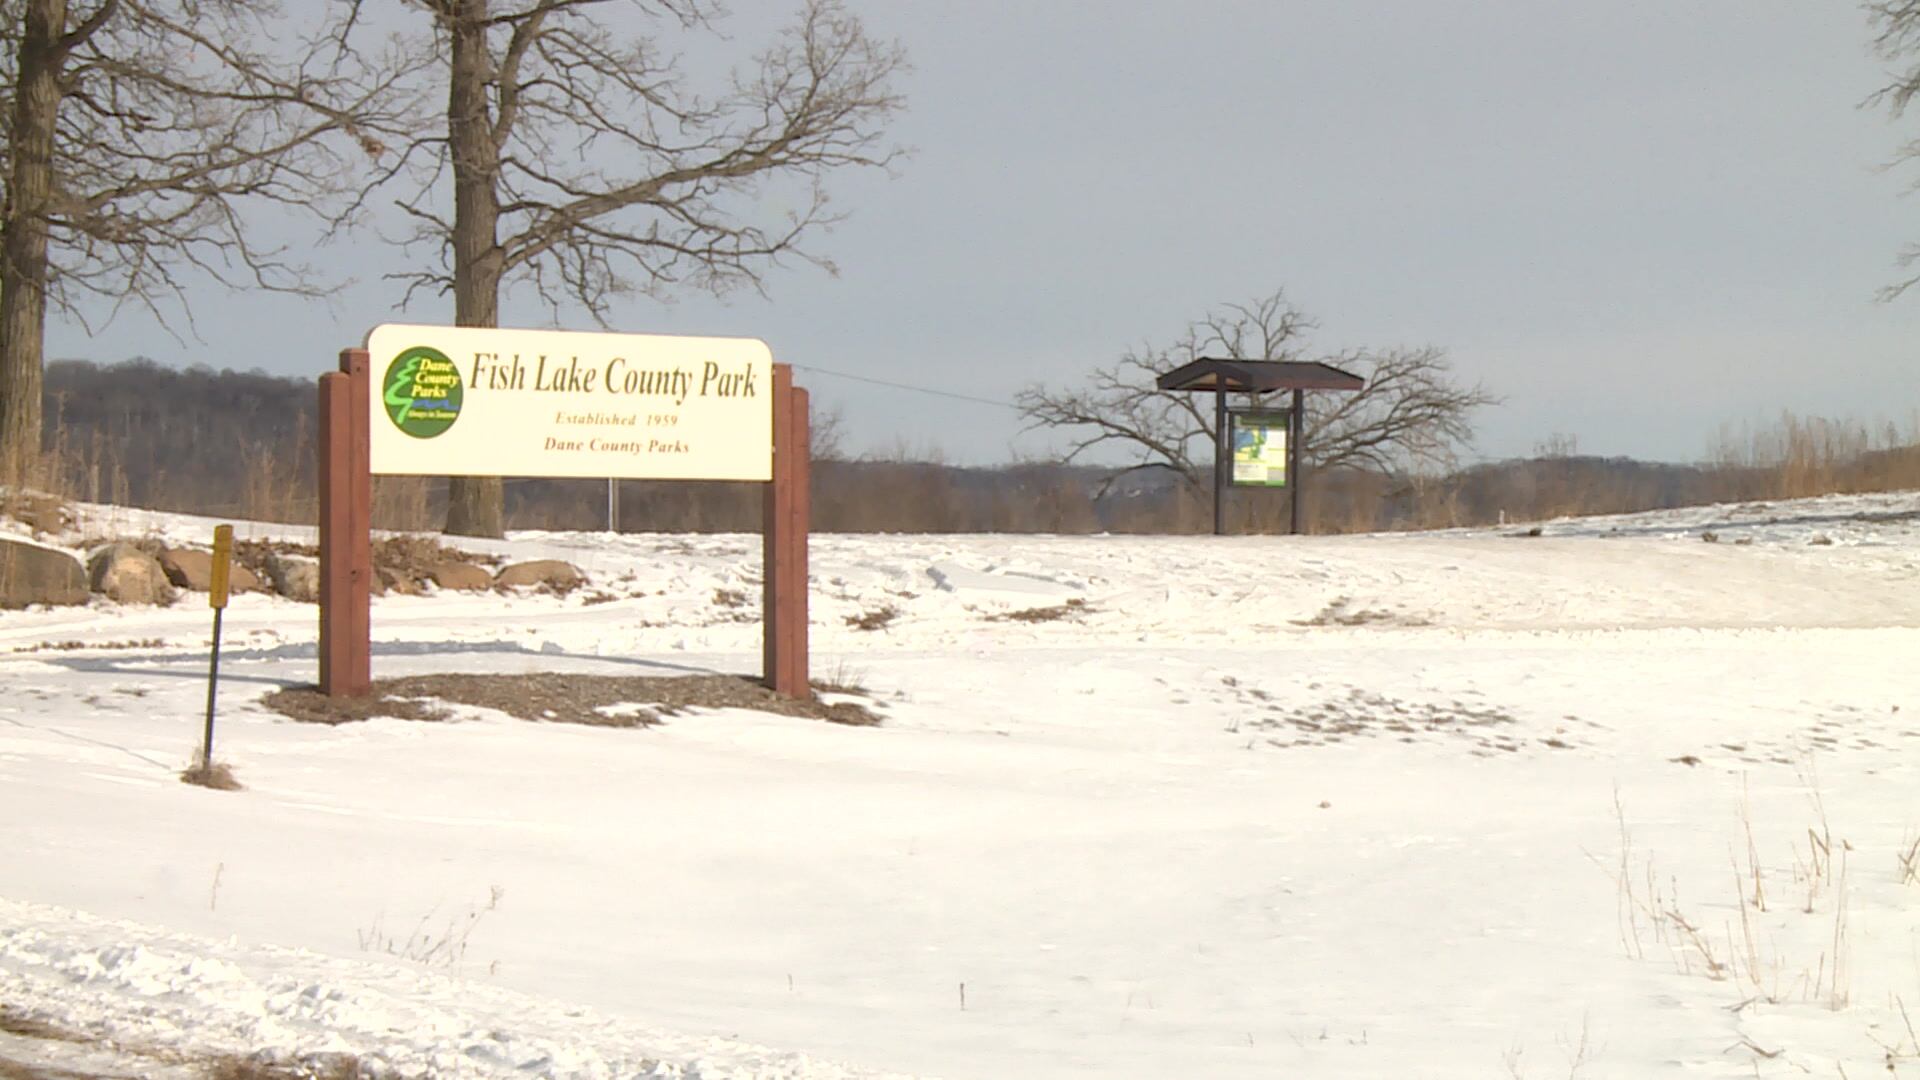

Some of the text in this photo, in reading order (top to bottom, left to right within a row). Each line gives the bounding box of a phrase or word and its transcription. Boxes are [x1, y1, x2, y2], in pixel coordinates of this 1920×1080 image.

[420, 358, 453, 371] Dane
[415, 371, 459, 388] County
[469, 352, 756, 406] Fish Lake County Park
[411, 384, 448, 398] Parks
[555, 411, 678, 426] Established 1959
[544, 437, 689, 455] Dane County Parks
